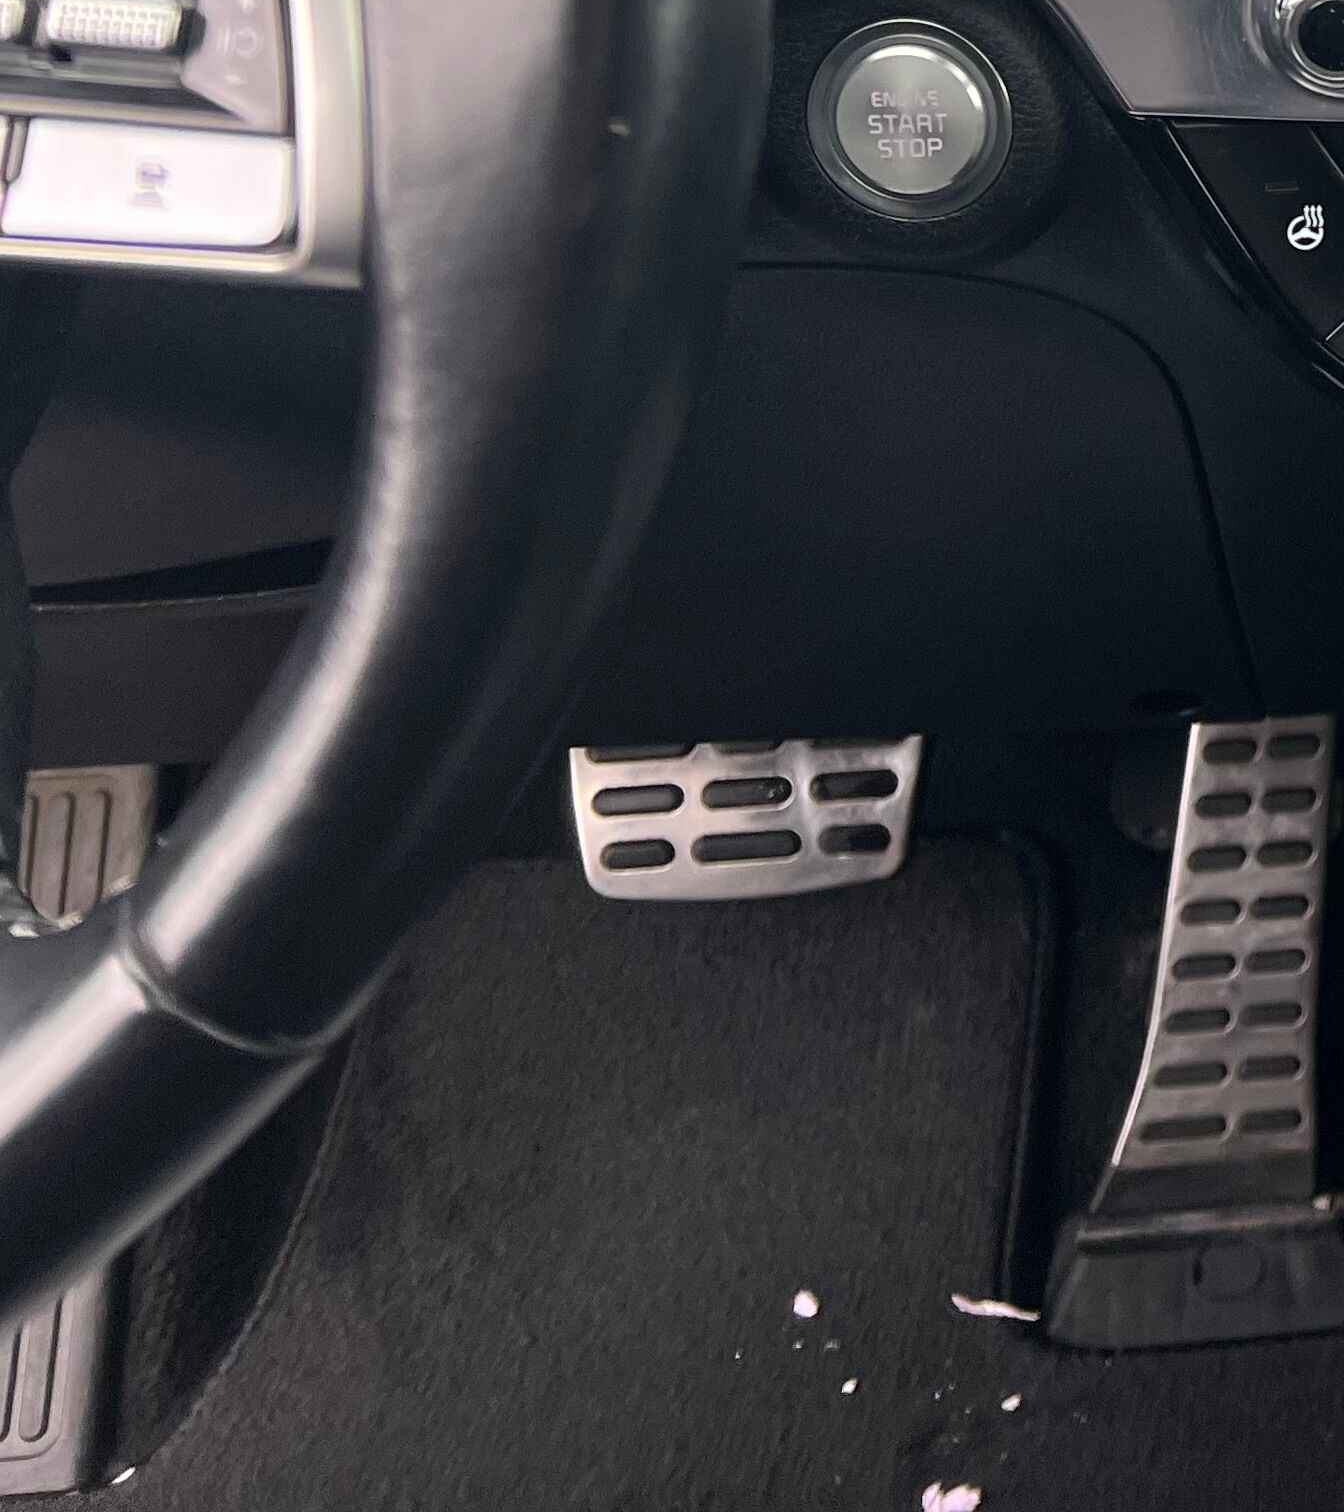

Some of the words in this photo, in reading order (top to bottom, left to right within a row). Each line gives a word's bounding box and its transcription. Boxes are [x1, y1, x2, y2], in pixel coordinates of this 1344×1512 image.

[871, 90, 939, 108] ENINE
[867, 113, 948, 134] START
[877, 138, 944, 159] STOP
